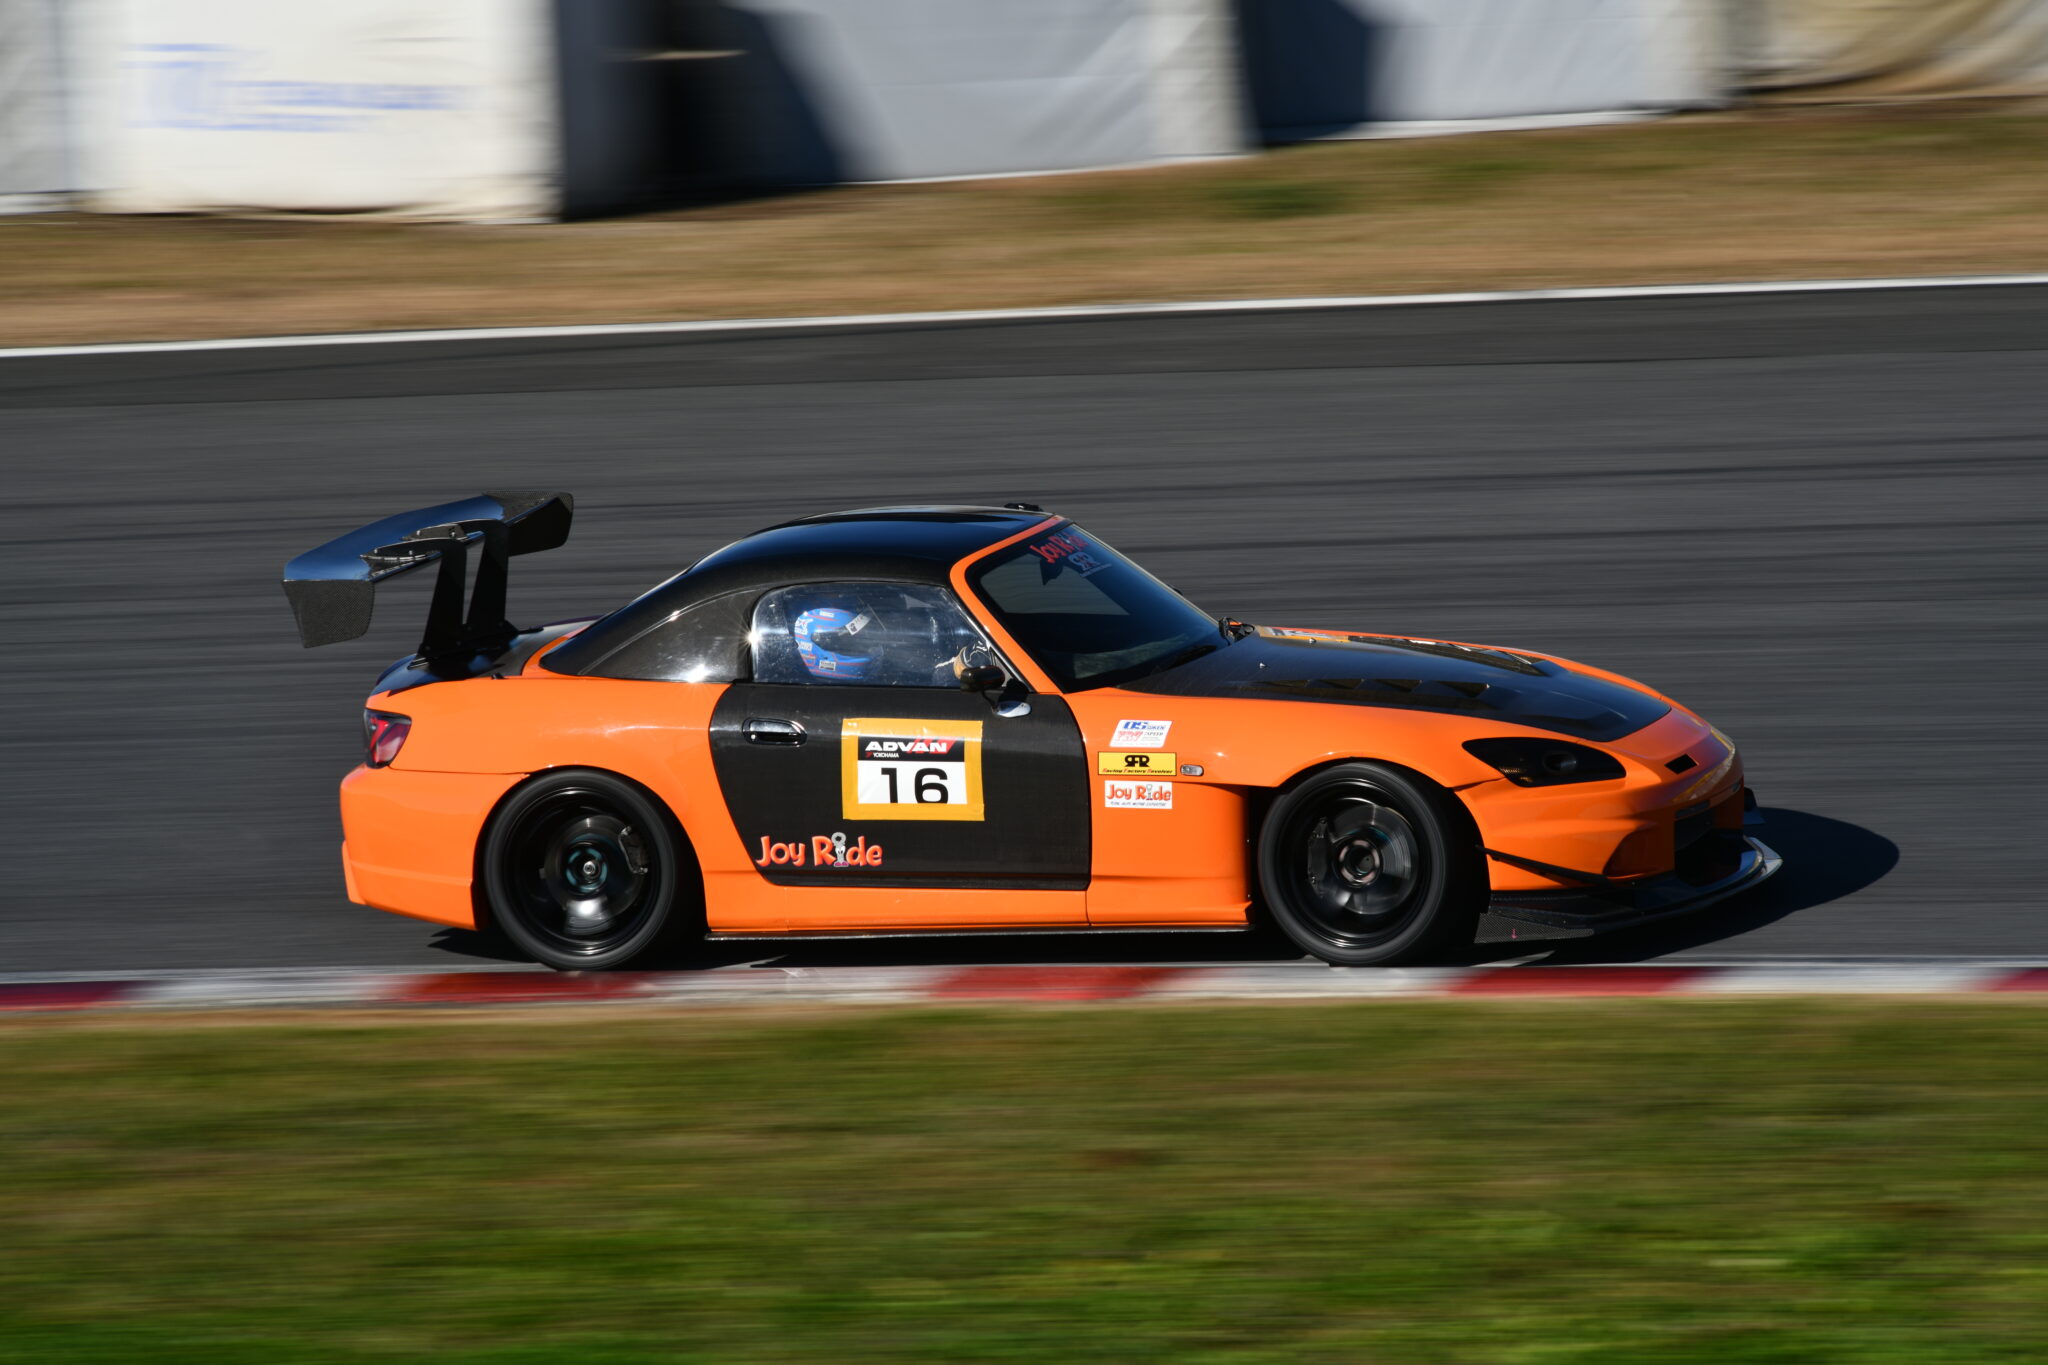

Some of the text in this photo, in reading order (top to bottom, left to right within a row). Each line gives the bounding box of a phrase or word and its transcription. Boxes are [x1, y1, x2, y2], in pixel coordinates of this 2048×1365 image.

[865, 741, 947, 752] ADVAN
[880, 767, 949, 804] 16
[1107, 783, 1171, 801] Joy Ride
[756, 831, 883, 867] Joy Ride
